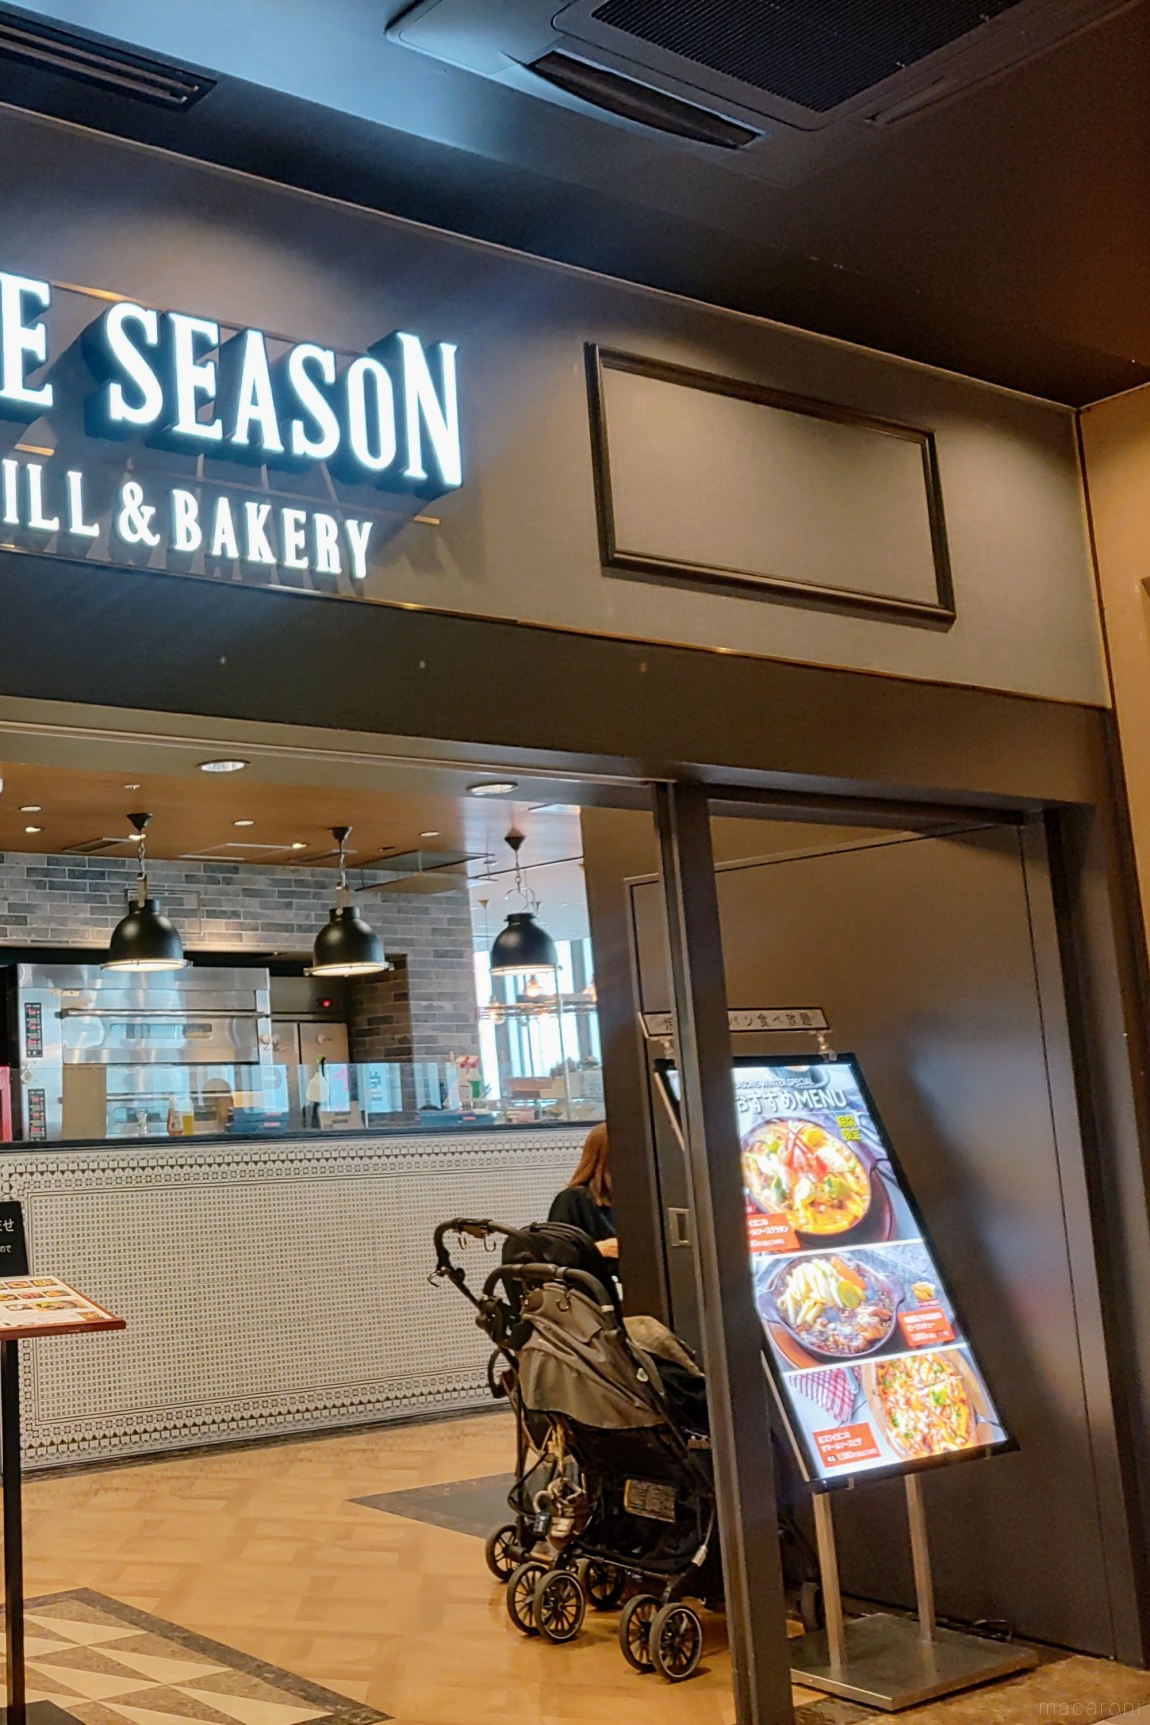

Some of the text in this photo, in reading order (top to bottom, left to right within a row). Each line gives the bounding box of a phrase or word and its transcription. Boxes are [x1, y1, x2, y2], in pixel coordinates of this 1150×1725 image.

[105, 302, 462, 489] SEASON
[118, 480, 160, 547] &
[172, 488, 374, 579] BAKERY
